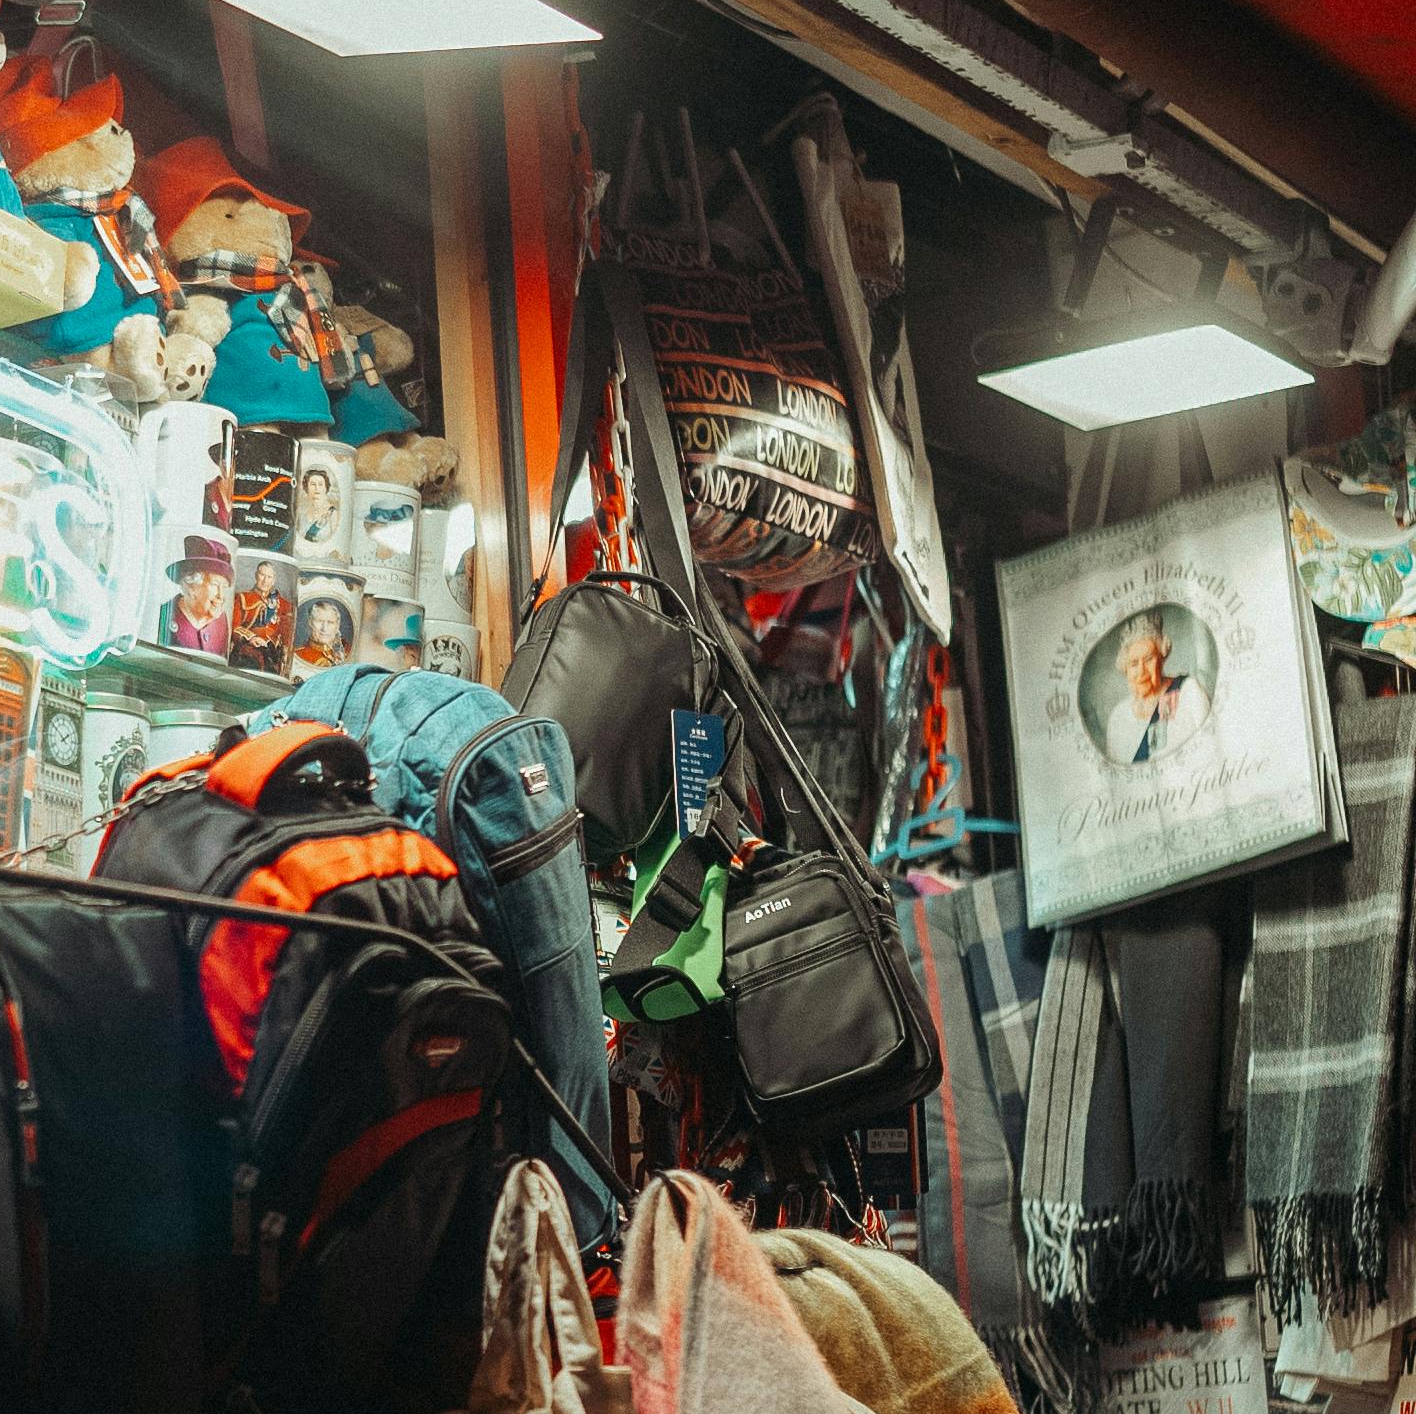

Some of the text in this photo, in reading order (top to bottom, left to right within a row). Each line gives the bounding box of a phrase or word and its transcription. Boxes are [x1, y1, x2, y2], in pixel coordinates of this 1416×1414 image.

[776, 378, 838, 429] LONDON
[755, 424, 821, 483] LONDON
[764, 486, 839, 542] LONDON
[1072, 578, 1136, 631] Queen
[1142, 560, 1227, 601] Elizabeth
[1055, 785, 1186, 845] Platinum
[743, 896, 793, 925] AoTian
[1193, 1356, 1252, 1388] HILL
